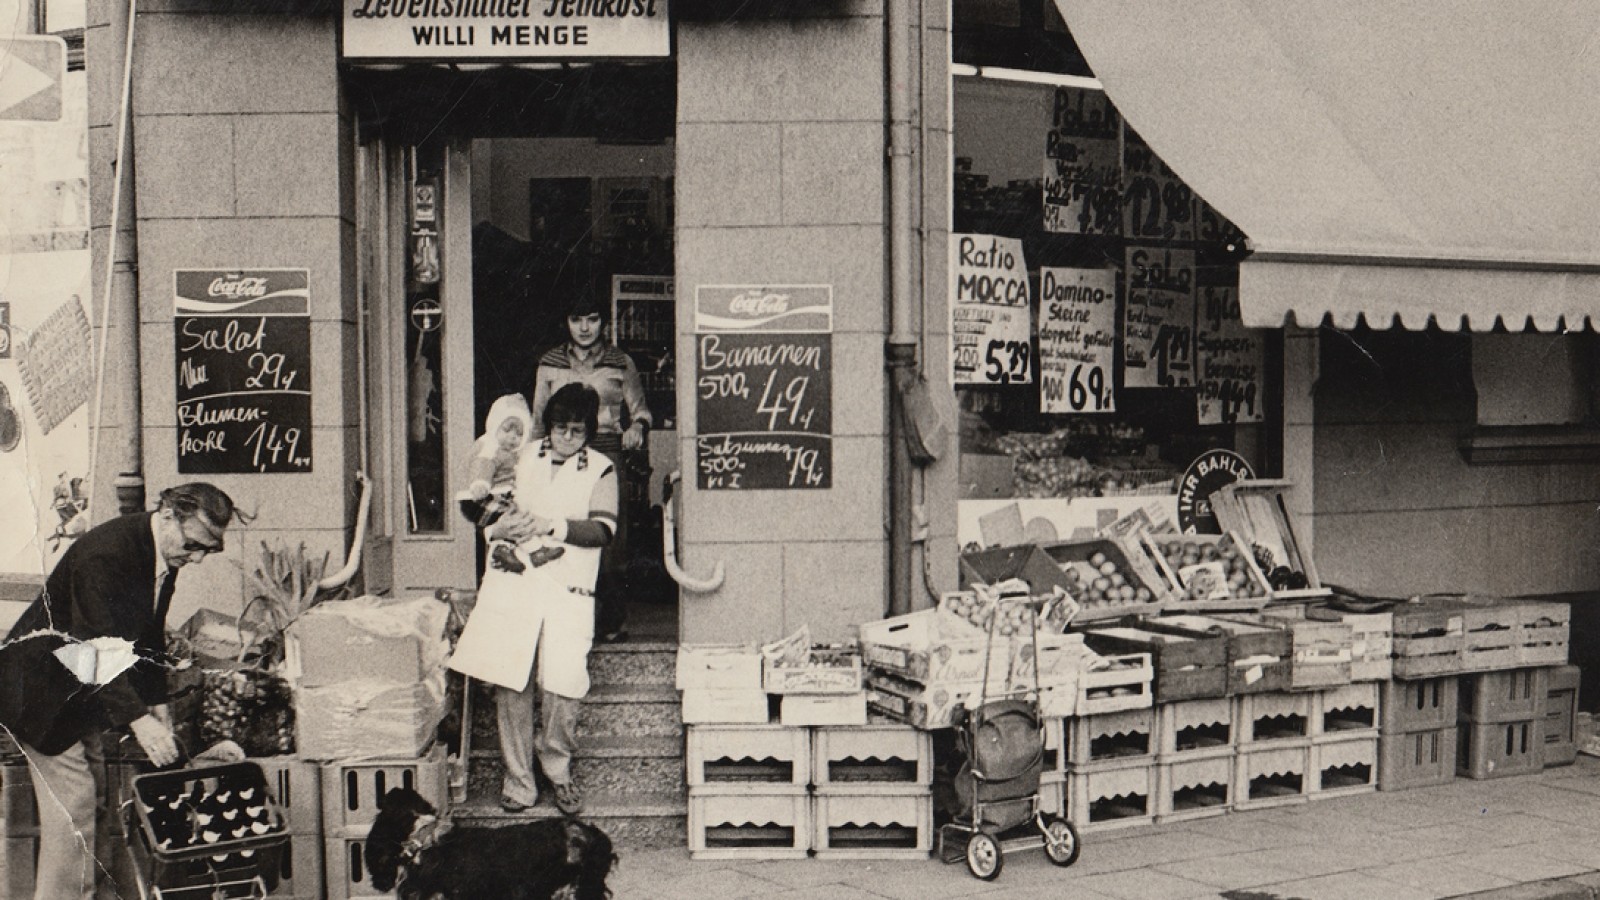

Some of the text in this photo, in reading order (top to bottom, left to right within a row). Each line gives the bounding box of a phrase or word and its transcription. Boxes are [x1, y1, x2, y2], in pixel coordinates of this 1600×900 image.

[412, 25, 589, 46] WILLI MENGE
[959, 236, 1015, 270] Ratio
[957, 274, 1028, 307] MOCCA
[180, 315, 268, 354] Salat
[701, 334, 821, 371] Bananen
[177, 402, 270, 427] Blumen-
[1180, 474, 1199, 512] IHR
